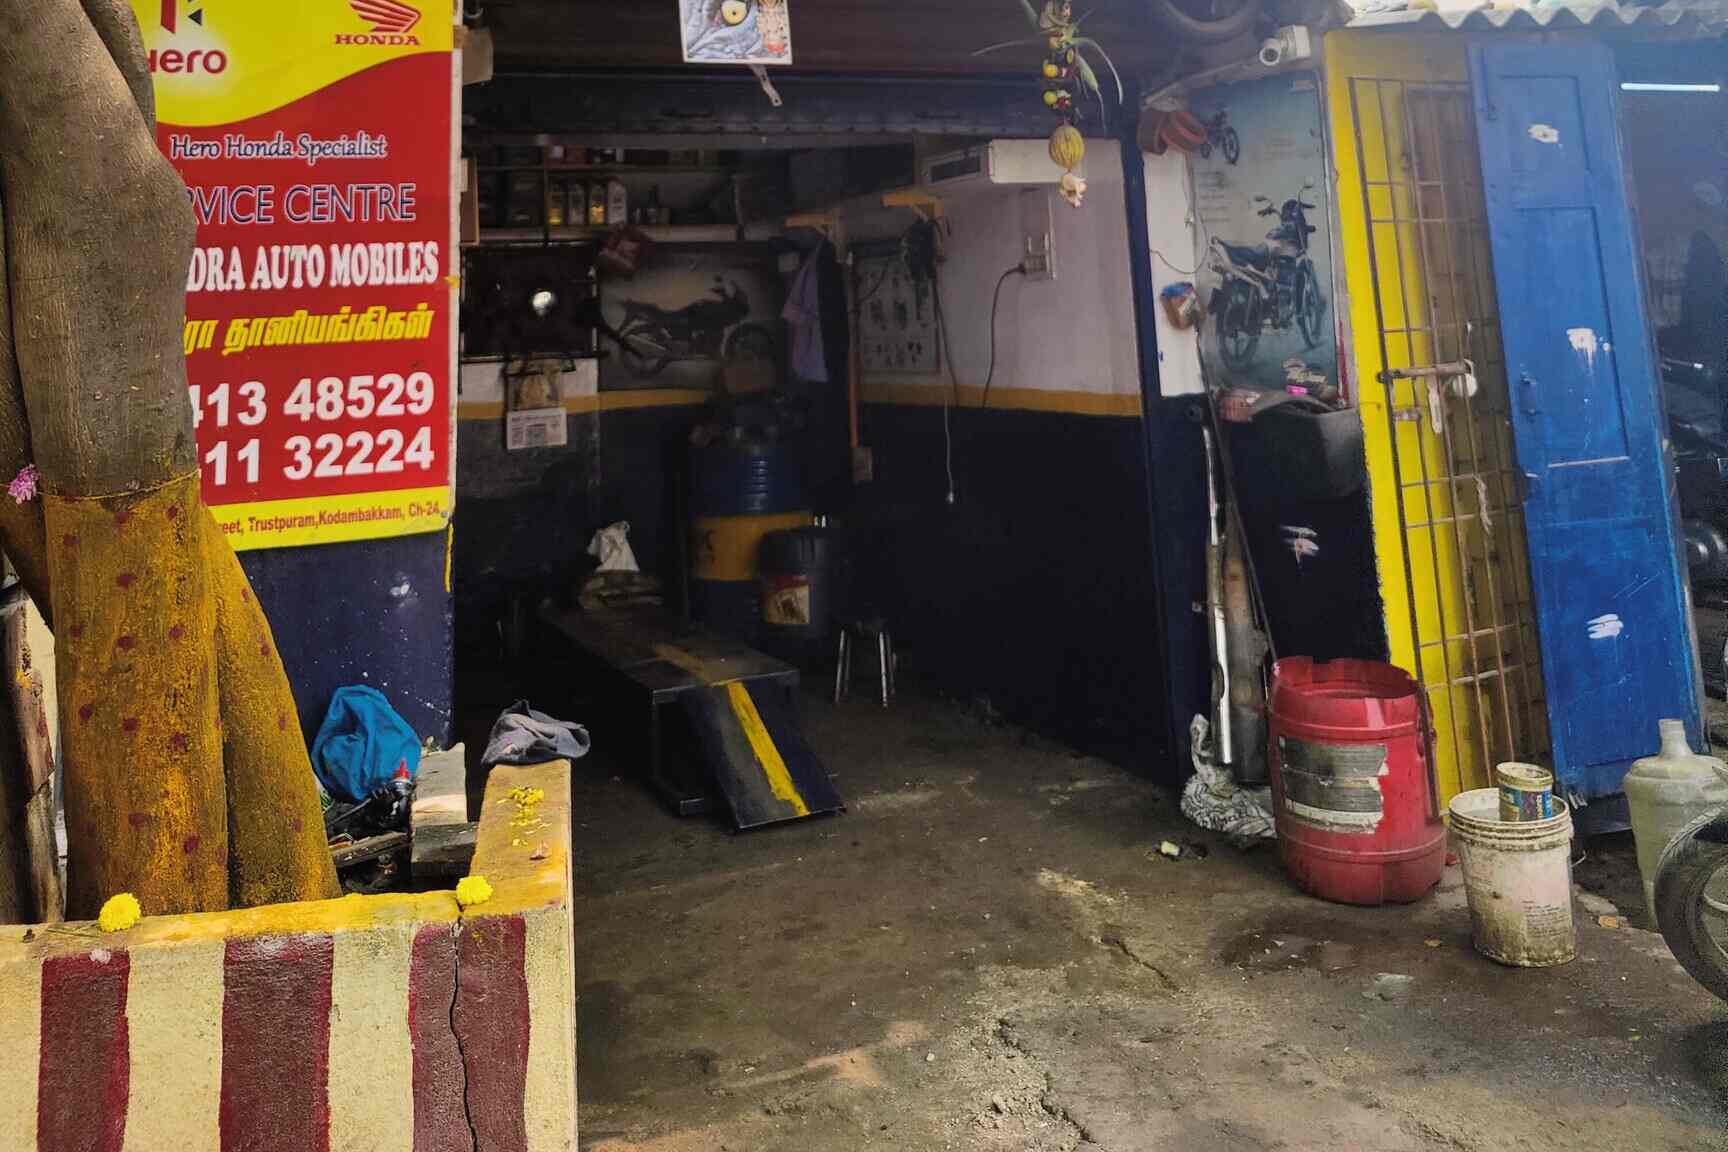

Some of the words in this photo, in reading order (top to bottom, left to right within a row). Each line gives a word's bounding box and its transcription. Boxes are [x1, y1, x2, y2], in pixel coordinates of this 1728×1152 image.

[335, 33, 420, 47] HONDA
[170, 133, 220, 159] Hero
[225, 130, 294, 159] Honda
[296, 130, 388, 166] Specialist
[284, 183, 416, 223] CENTRE
[186, 245, 246, 293] DRA
[250, 243, 325, 290] AUTO
[329, 240, 440, 288] MOBILES
[283, 371, 435, 422] 48529
[195, 438, 260, 486] 11
[283, 426, 435, 480] 32224
